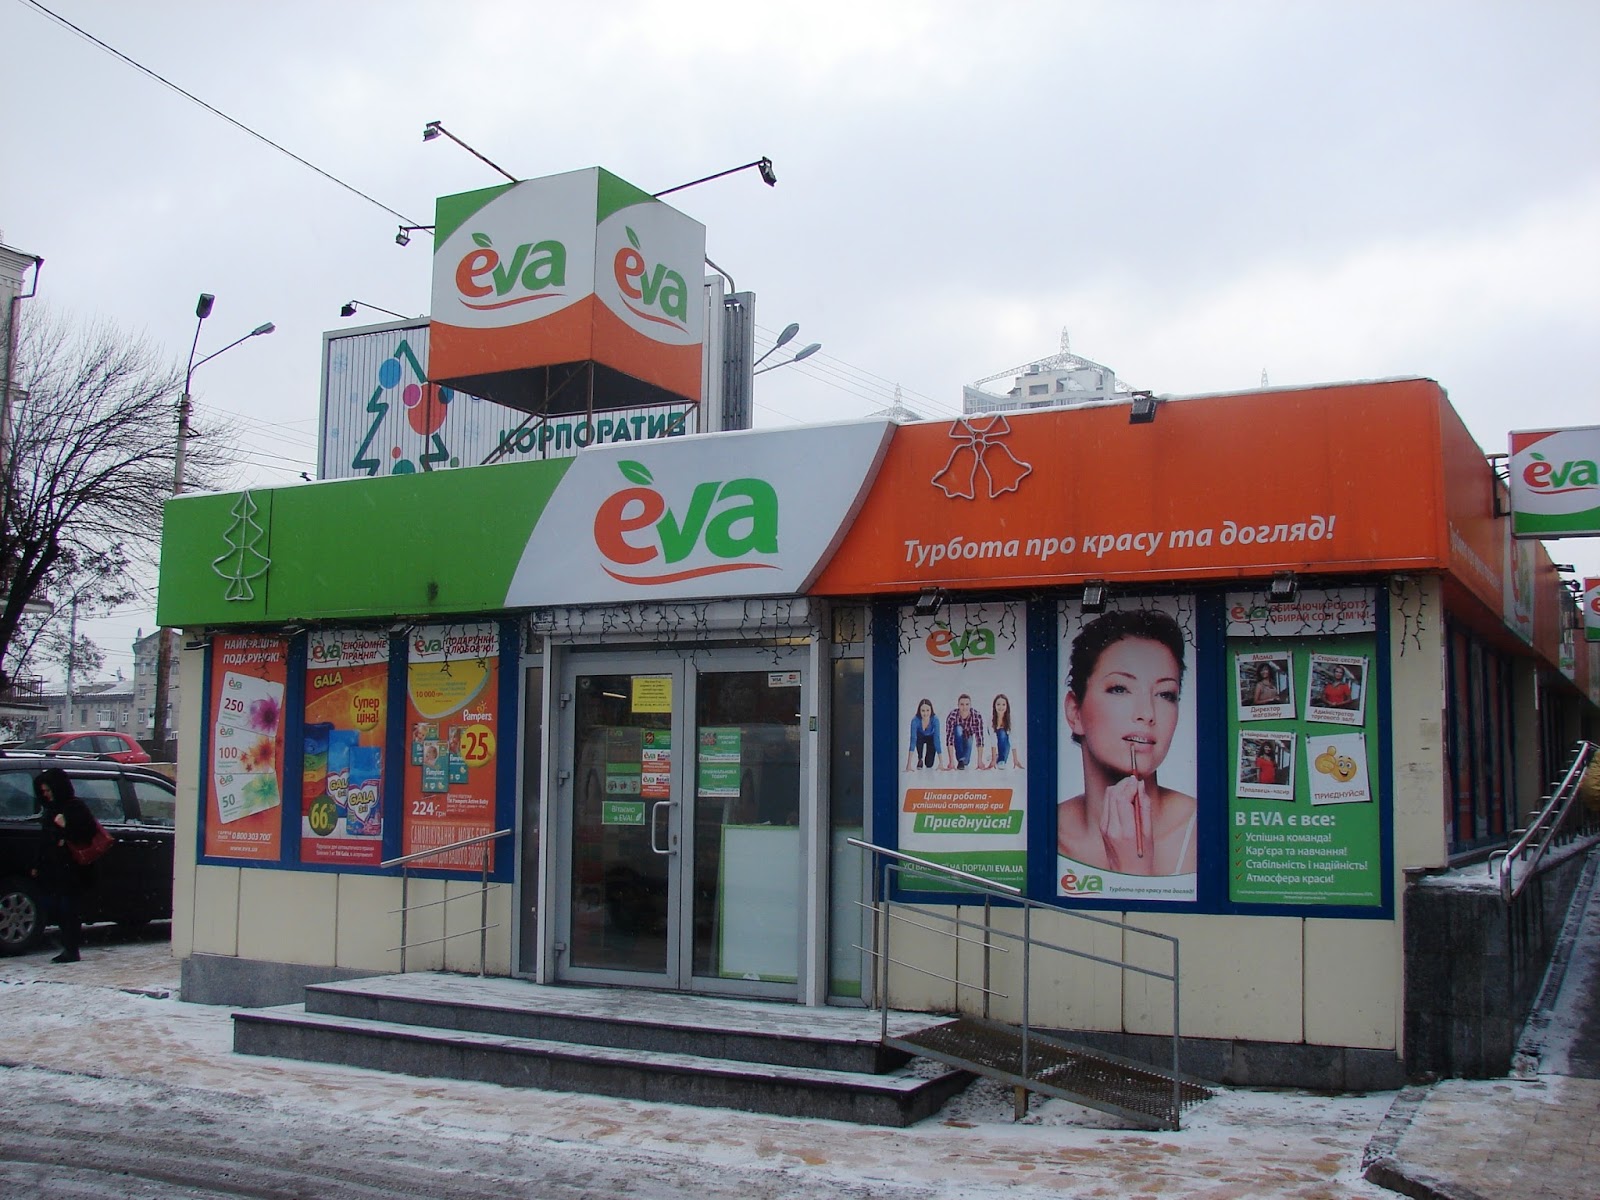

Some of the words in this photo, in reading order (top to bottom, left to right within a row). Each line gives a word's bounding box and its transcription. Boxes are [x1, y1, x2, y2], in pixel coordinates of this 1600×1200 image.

[500, 412, 686, 454] КОРПОРАТИВ
[904, 536, 1018, 568] Турбота
[1025, 537, 1076, 561] про
[1082, 529, 1163, 558] красу
[1169, 525, 1213, 547] та
[1219, 515, 1336, 545] догляд!
[1270, 612, 1310, 622] ОБИРАЙ
[1311, 612, 1334, 622] СОБІ
[445, 635, 495, 645] ПОДАРУНКИ
[223, 653, 280, 665] ПОДАРУНОК!
[342, 650, 377, 660] ПРАННЯ!
[1317, 655, 1338, 663] Старша
[314, 672, 342, 689] GALA
[224, 698, 244, 713] 250
[353, 696, 380, 712] Супер
[463, 709, 492, 722] Pampers
[1250, 706, 1281, 715] Директор
[1313, 709, 1354, 718] Адміністратор
[356, 710, 379, 725] ціна!
[461, 732, 489, 761] -25
[219, 747, 238, 759] 100
[329, 778, 348, 791] GAL
[349, 790, 376, 805] GALA
[923, 791, 952, 801] Цікава
[953, 791, 987, 802] робота
[1314, 789, 1365, 800] ПРИЄДНУЙСЯ!
[222, 794, 236, 808] 50
[912, 801, 947, 810] успішний
[948, 802, 974, 811] старт
[412, 801, 434, 816] 224
[435, 810, 446, 818] грн
[310, 803, 329, 830] 66
[1235, 812, 1246, 826] В
[1250, 811, 1284, 826] EVA
[1287, 815, 1297, 826] є
[1301, 815, 1336, 826] все:
[923, 815, 1012, 832] Приєднуйся!
[247, 832, 259, 841] 303
[1246, 832, 1285, 843] Успішна
[1286, 833, 1332, 843] команда!
[1246, 846, 1283, 857] Кар'єра
[1285, 848, 1296, 856] та
[1297, 847, 1348, 856] навчання!
[962, 863, 994, 872] ПОРТАЛІ
[995, 864, 1024, 873] EVA.UA
[1246, 859, 1306, 870] Стабільність
[1313, 860, 1368, 871] надійність!
[1246, 873, 1301, 885] Атмосфера
[1302, 874, 1335, 885] краси!
